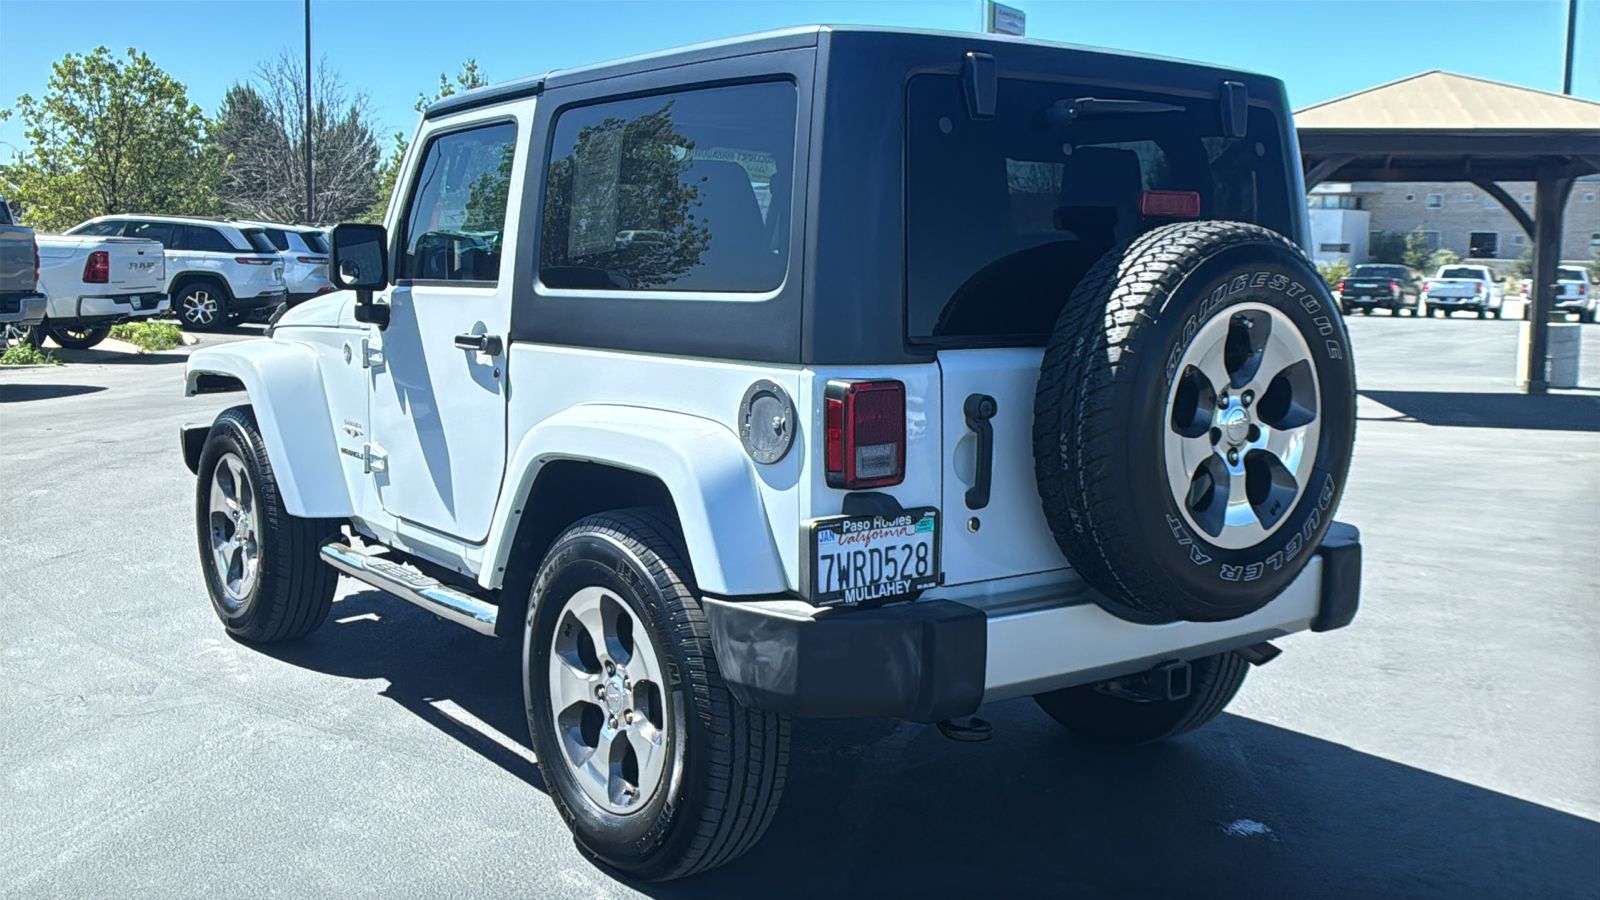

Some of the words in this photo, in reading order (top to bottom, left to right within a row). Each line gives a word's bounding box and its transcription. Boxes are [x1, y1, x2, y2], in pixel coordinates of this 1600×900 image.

[1166, 272, 1342, 386] BRIDGESTONE
[819, 530, 835, 543] JAN
[838, 526, 916, 548] California
[842, 520, 870, 533] Paso
[1166, 513, 1213, 566] A/T
[1219, 472, 1335, 582] DUELER
[820, 541, 929, 593] 7WRD528
[845, 579, 912, 603] MULLAHEY
